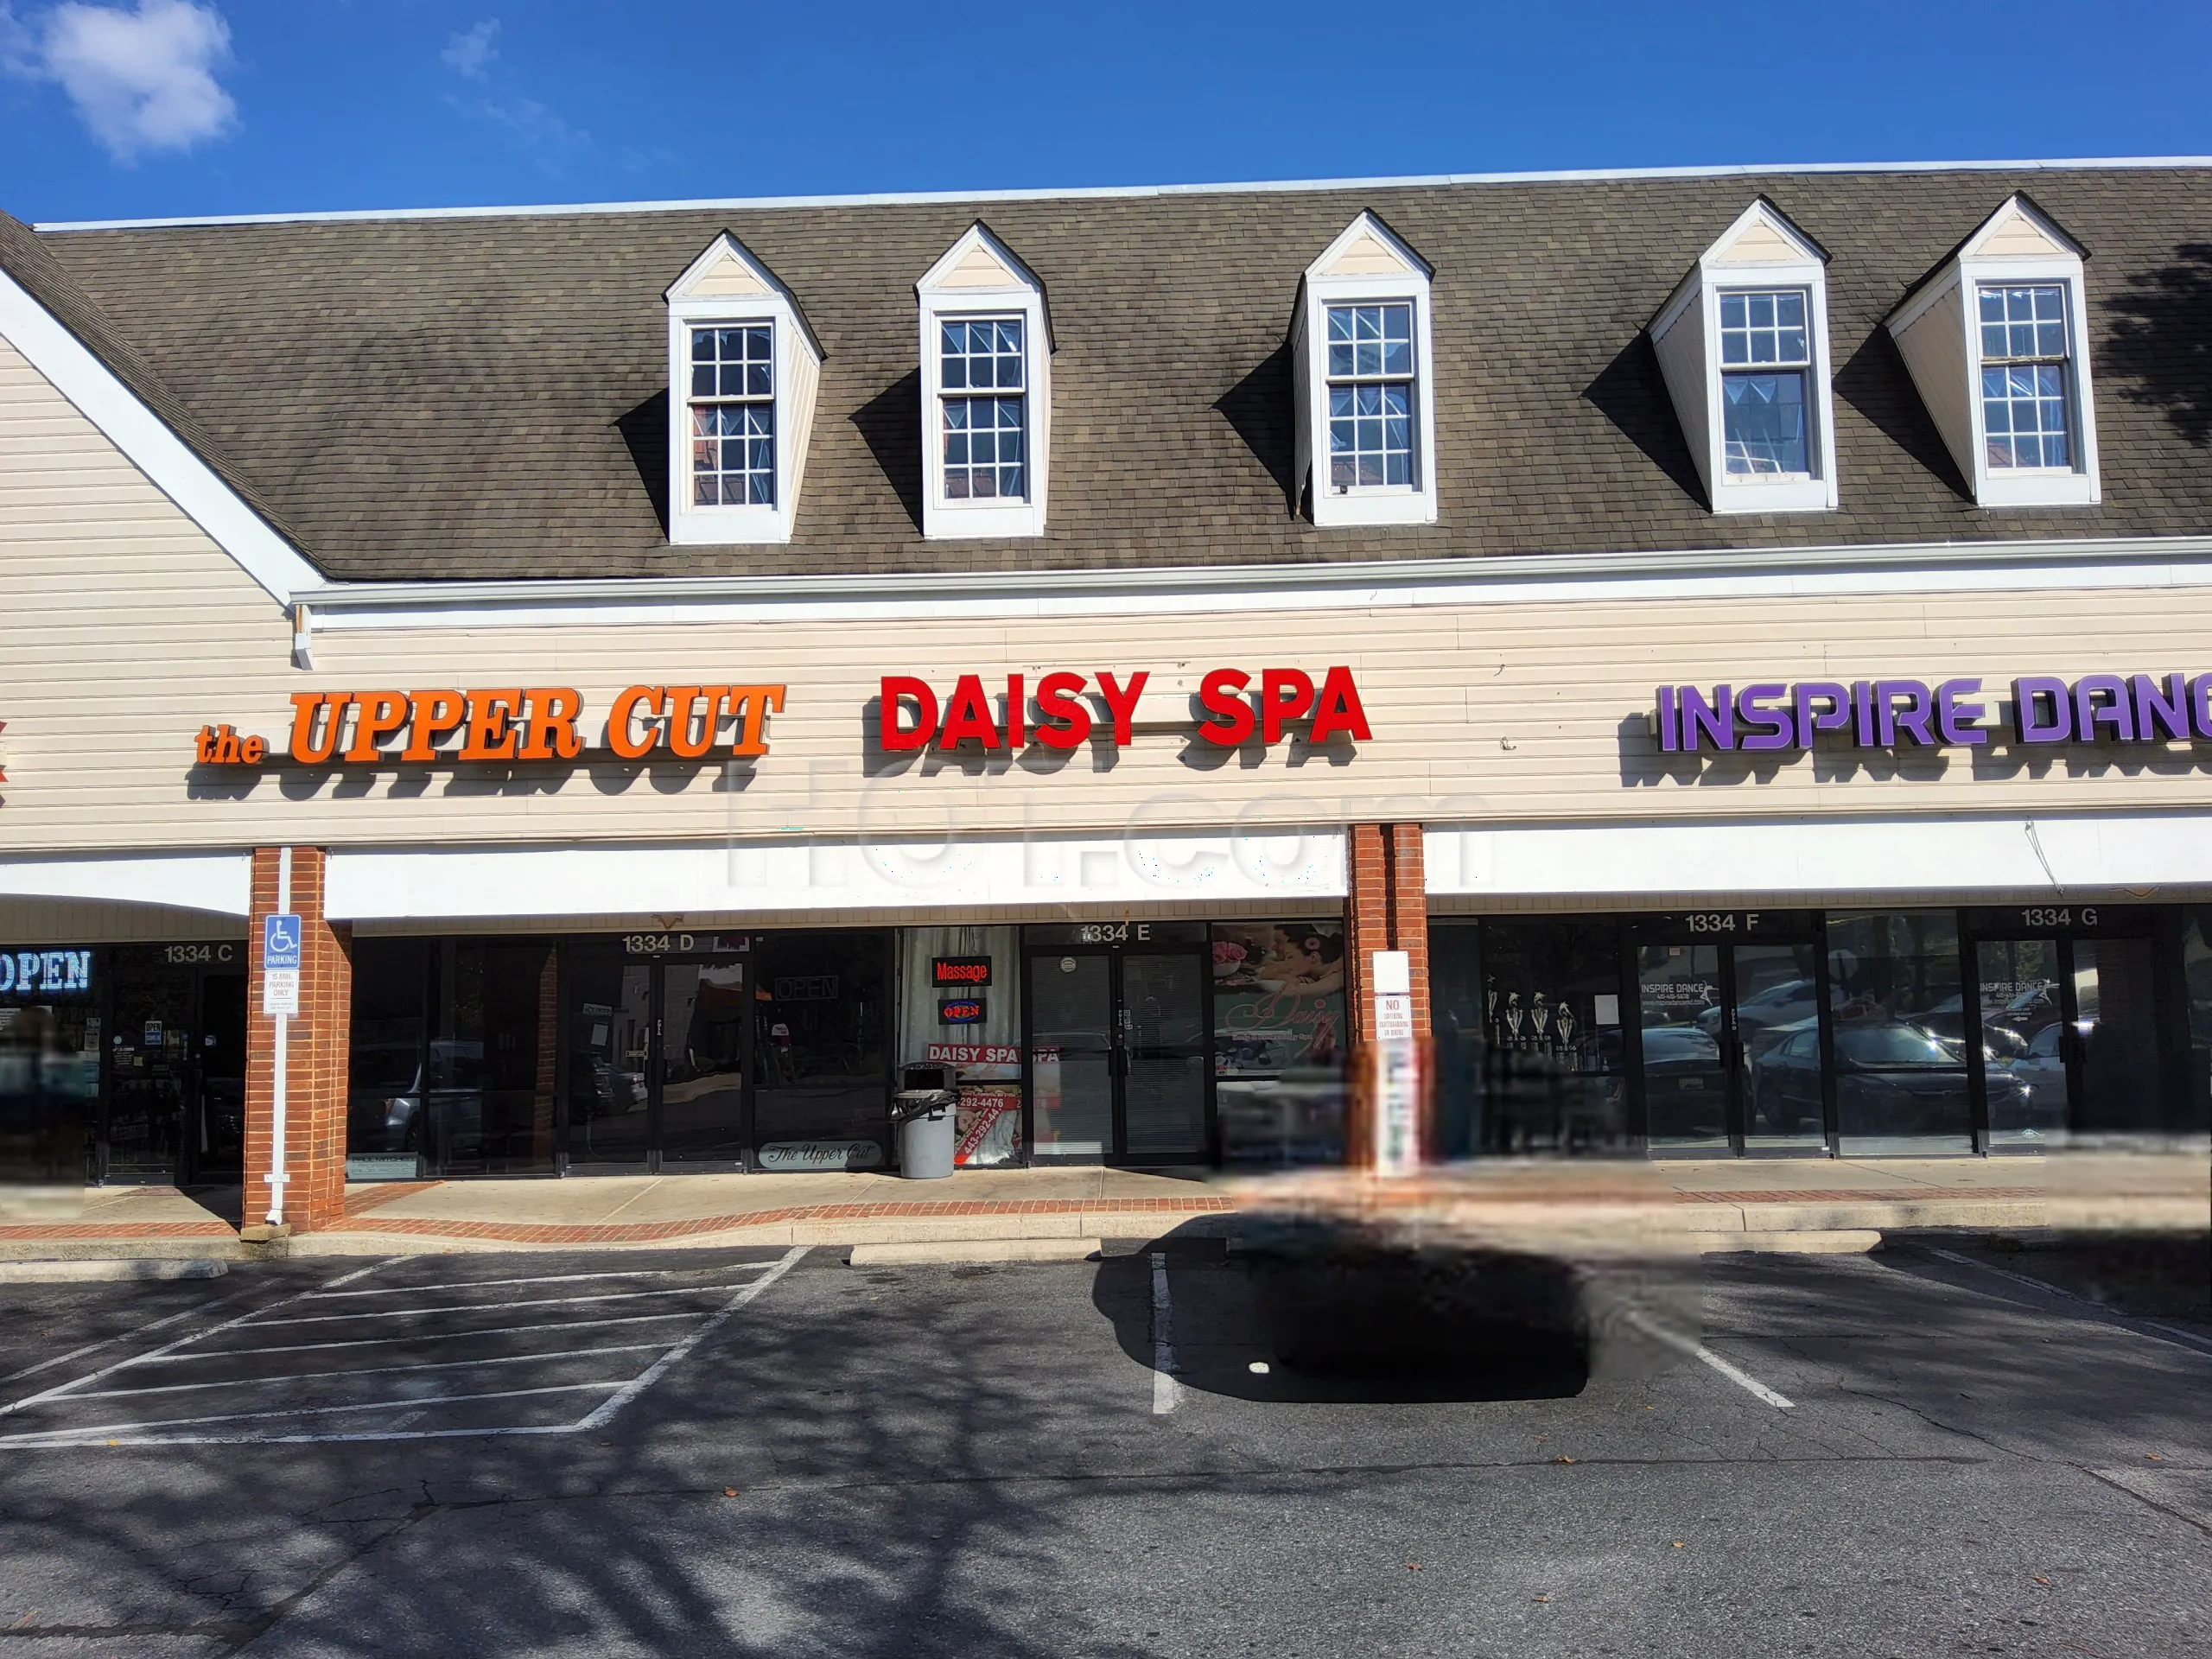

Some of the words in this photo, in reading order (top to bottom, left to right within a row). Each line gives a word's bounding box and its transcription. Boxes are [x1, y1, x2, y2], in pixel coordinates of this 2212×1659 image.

[881, 671, 1150, 751] DAISY
[1198, 666, 1373, 746] SPA
[1656, 678, 1986, 751] INSPIRE
[194, 724, 264, 764] the
[289, 687, 583, 764] UPPER
[608, 684, 787, 758] CUT
[1685, 914, 1736, 931] 1334
[1746, 913, 1759, 931] F
[2022, 908, 2071, 926] 1334
[2081, 907, 2098, 926] G
[1081, 925, 1128, 941] 1334
[1137, 925, 1150, 940] E
[622, 935, 671, 951] 1334
[680, 934, 695, 950] D
[165, 945, 211, 963] 1334
[218, 944, 233, 962] C
[267, 955, 297, 965] PARKING
[937, 962, 987, 982] Massage
[779, 977, 836, 1000] OPEN
[1641, 983, 1675, 993] INSPIRE
[1676, 983, 1703, 993] DANCE
[1980, 982, 2013, 992] INSPIRE
[2015, 982, 2043, 992] DANCE
[944, 1005, 980, 1018] OPEN
[1385, 999, 1400, 1010] NO
[929, 1046, 981, 1061] DAISY
[986, 1047, 1018, 1063] SPA
[963, 1107, 1001, 1154] 443-292-44
[768, 1145, 798, 1163] The
[801, 1143, 843, 1164] Upper
[847, 1143, 876, 1160] Cut
